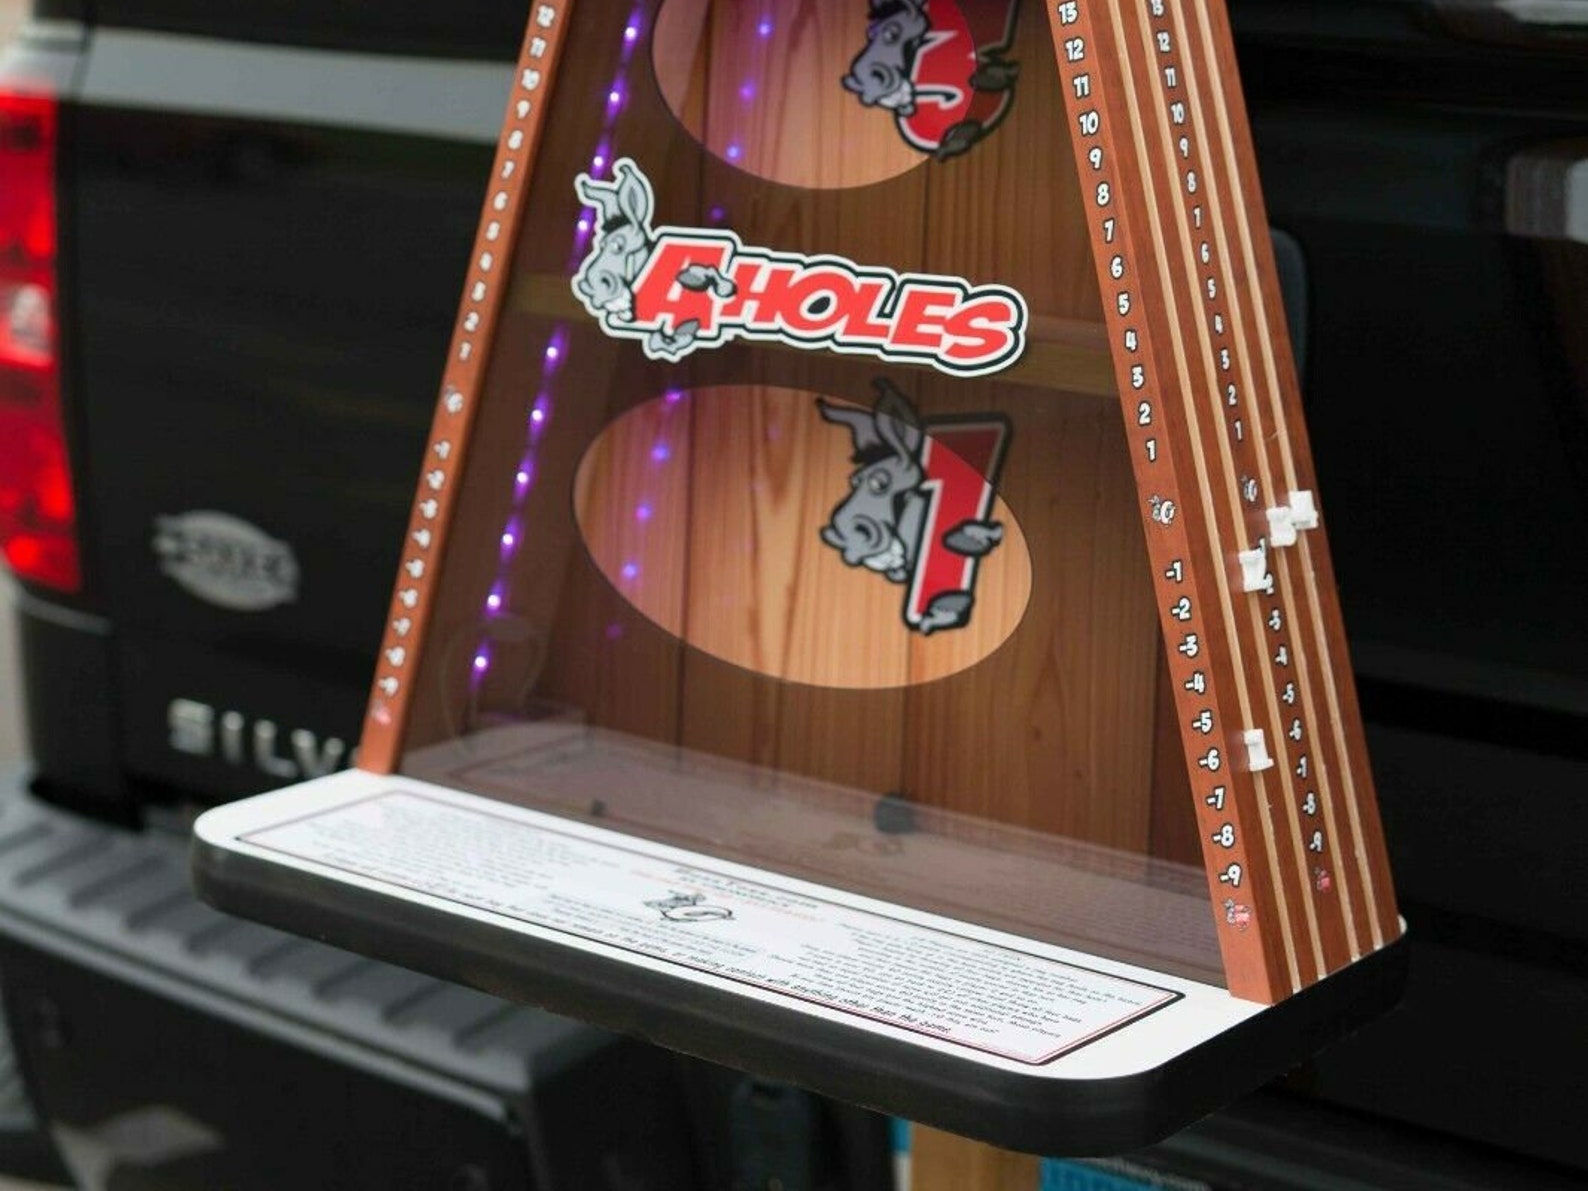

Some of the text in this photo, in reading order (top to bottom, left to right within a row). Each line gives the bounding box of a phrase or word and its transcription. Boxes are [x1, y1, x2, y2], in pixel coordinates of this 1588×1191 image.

[1058, 1, 1078, 23] 13
[1065, 38, 1084, 61] 12
[1073, 75, 1089, 97] 11
[1079, 111, 1099, 134] 10
[1088, 148, 1103, 169] 9
[1096, 183, 1111, 205] 8
[1110, 257, 1124, 278] 6
[1117, 293, 1131, 314] 5
[1124, 331, 1138, 351] 4
[1131, 366, 1145, 388] 3
[1138, 402, 1152, 425] 2
[1166, 561, 1182, 581] -1
[1172, 597, 1190, 620] -2
[1179, 635, 1198, 657] -3
[1185, 673, 1205, 693] -4
[1193, 711, 1212, 733] -5
[167, 697, 360, 780] SILV
[1199, 749, 1220, 770] -6
[1207, 787, 1224, 809] -7
[1213, 825, 1234, 847] -8
[1220, 864, 1241, 885] -9
